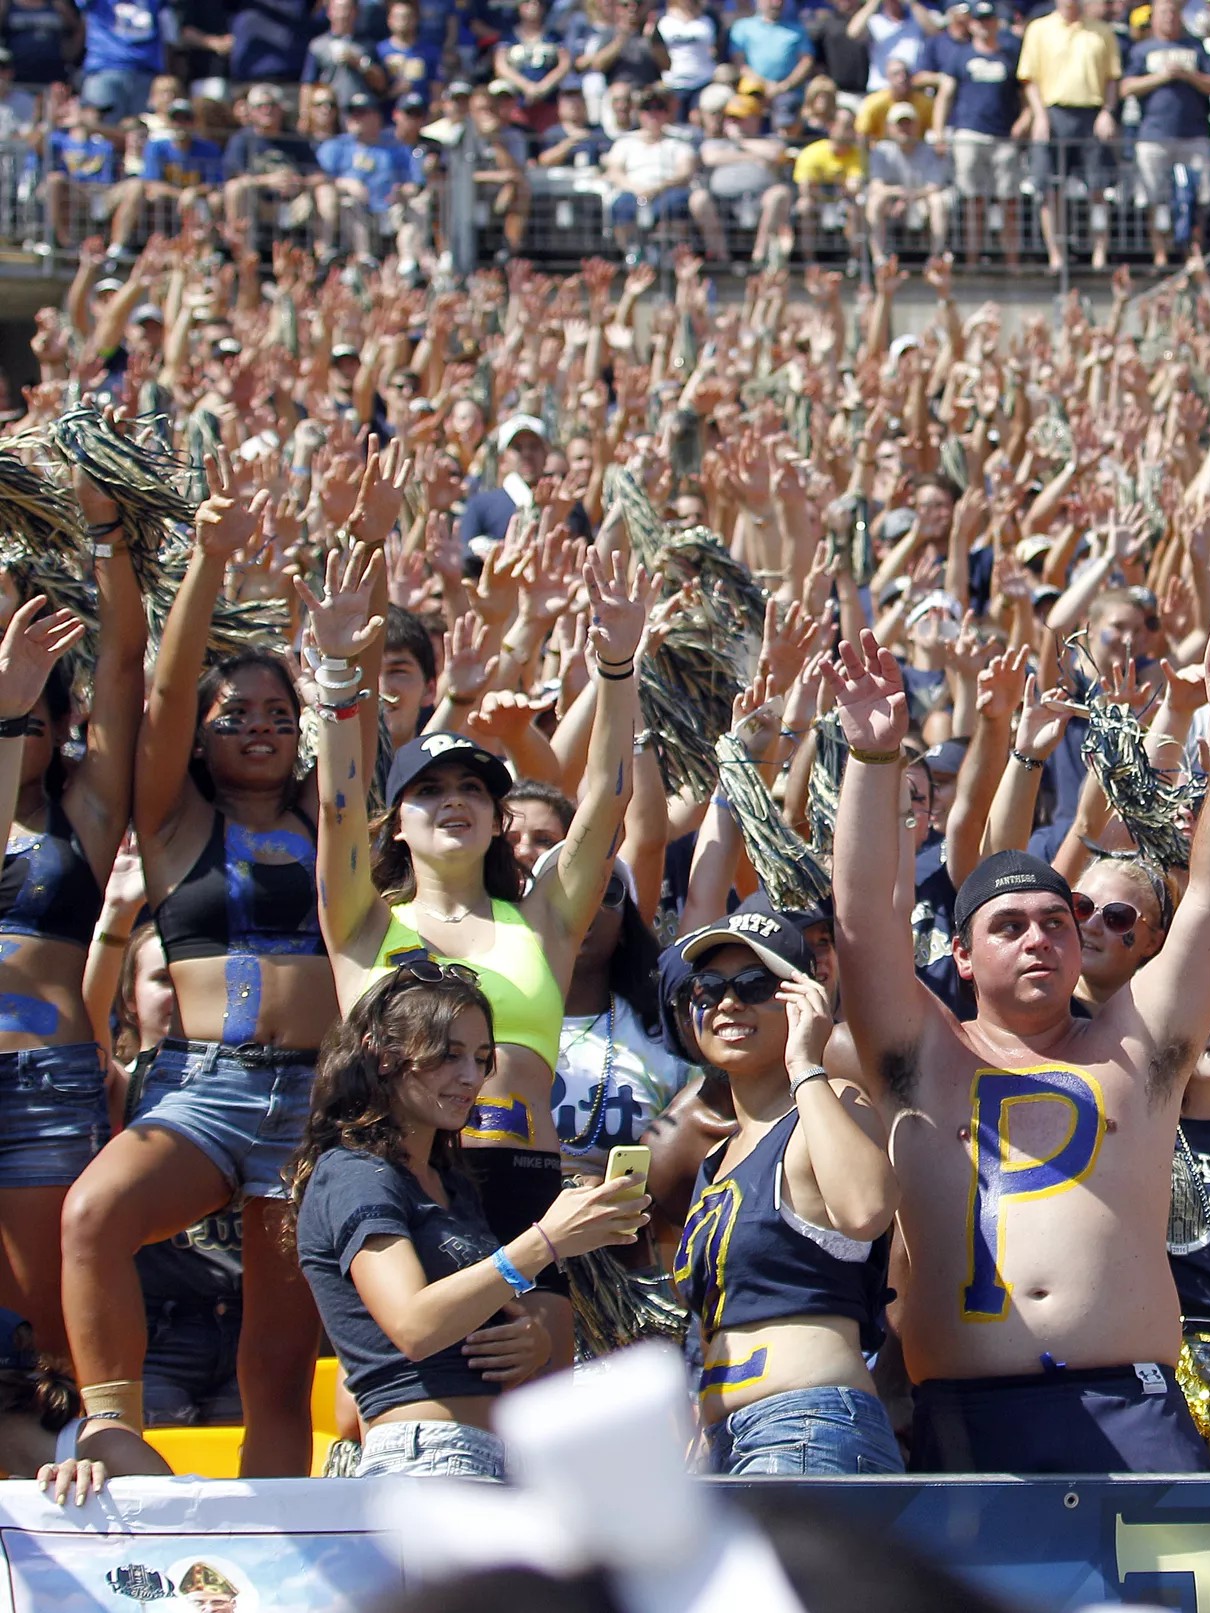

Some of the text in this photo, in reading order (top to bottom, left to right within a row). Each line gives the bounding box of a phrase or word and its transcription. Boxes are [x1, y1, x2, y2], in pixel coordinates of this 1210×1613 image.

[995, 874, 1037, 889] PANTHERS
[728, 913, 782, 938] PITT
[551, 1071, 643, 1150] itt
[513, 1155, 561, 1171] NIKE PR
[960, 1063, 1107, 1324] P
